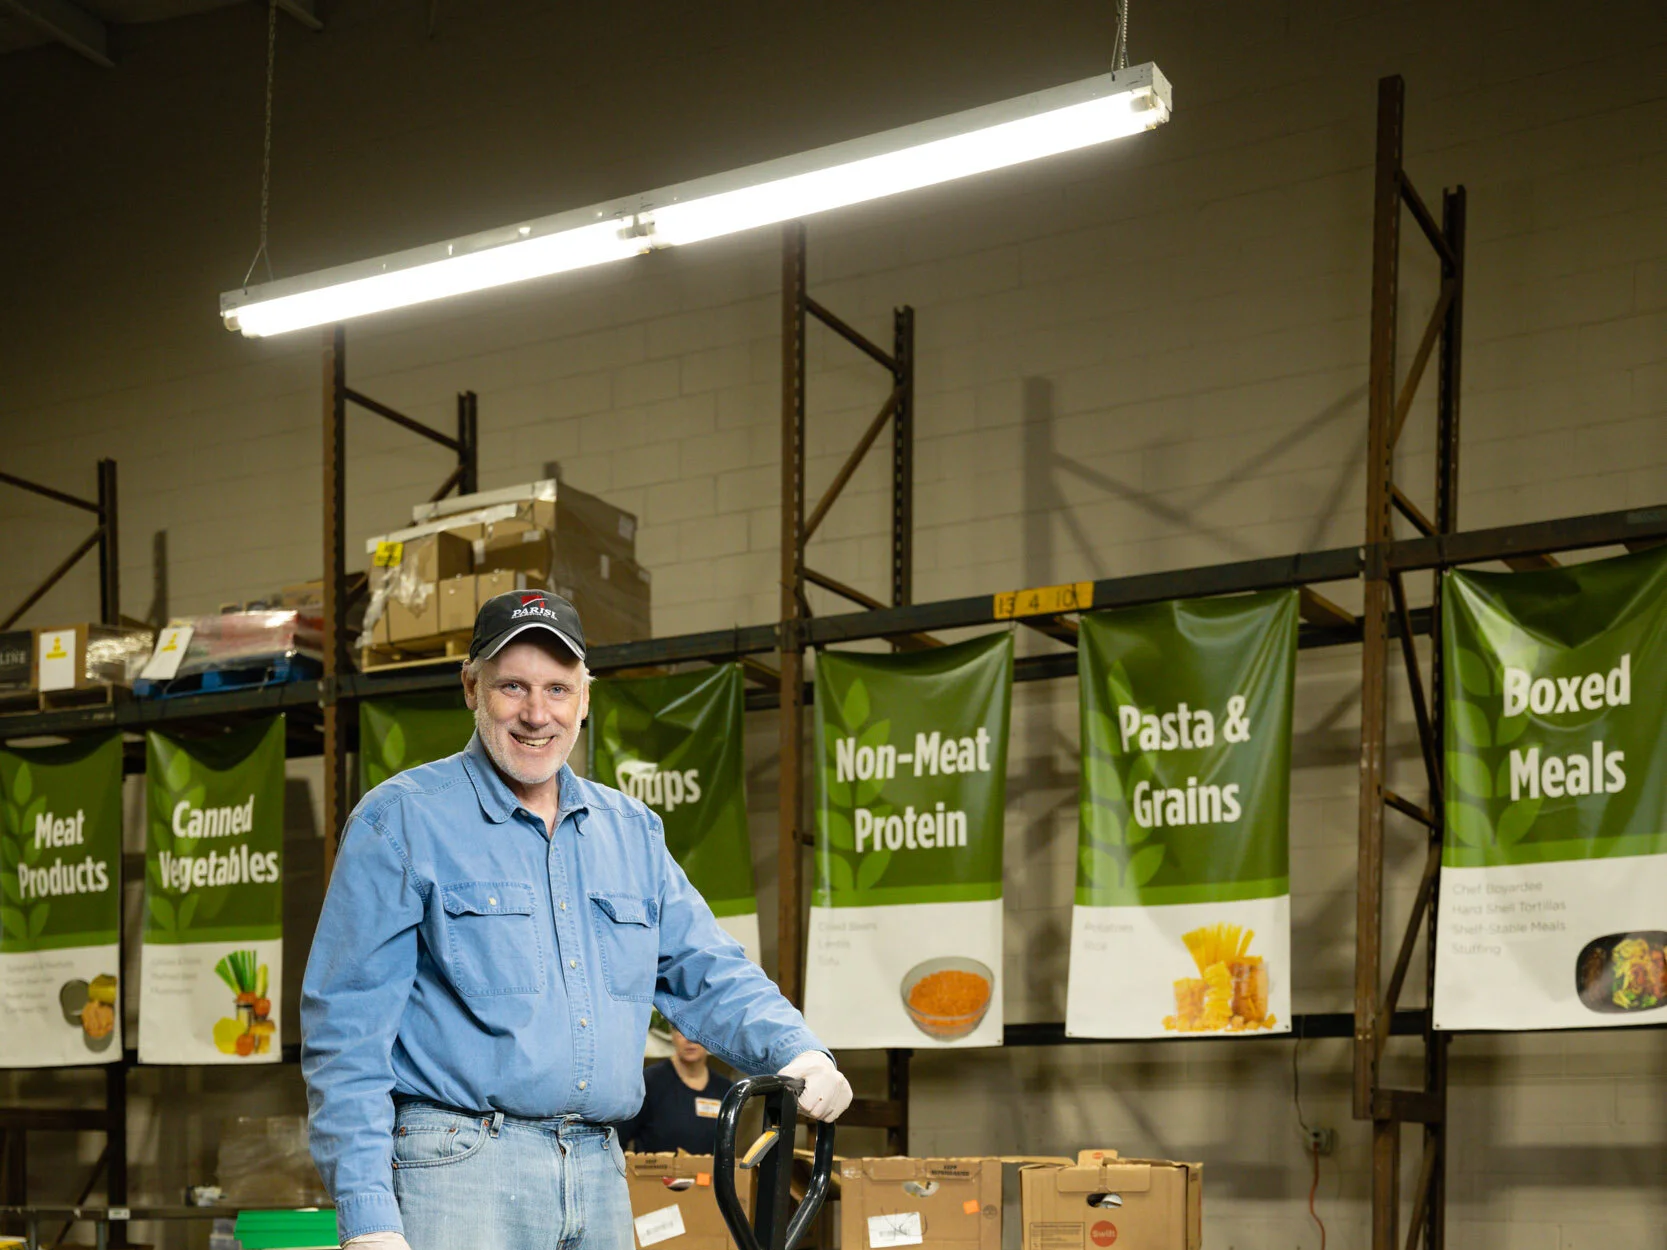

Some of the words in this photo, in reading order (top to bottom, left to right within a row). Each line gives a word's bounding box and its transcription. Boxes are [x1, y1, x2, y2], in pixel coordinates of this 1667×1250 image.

[511, 606, 557, 619] PARISI
[1028, 593, 1040, 610] 4
[1503, 653, 1632, 718] Boxed
[1118, 702, 1215, 752] Pasta
[1223, 695, 1251, 743] &
[835, 727, 991, 783] Non-Meat
[1509, 740, 1627, 801] Meals
[171, 794, 255, 839] Canned
[1133, 776, 1242, 828] Grains
[34, 808, 85, 850] Meat
[854, 802, 967, 853] Protein
[18, 855, 110, 900] Products
[159, 843, 279, 893] Vegetables
[1520, 899, 1567, 912] Tortillas
[1531, 920, 1566, 932] Meals
